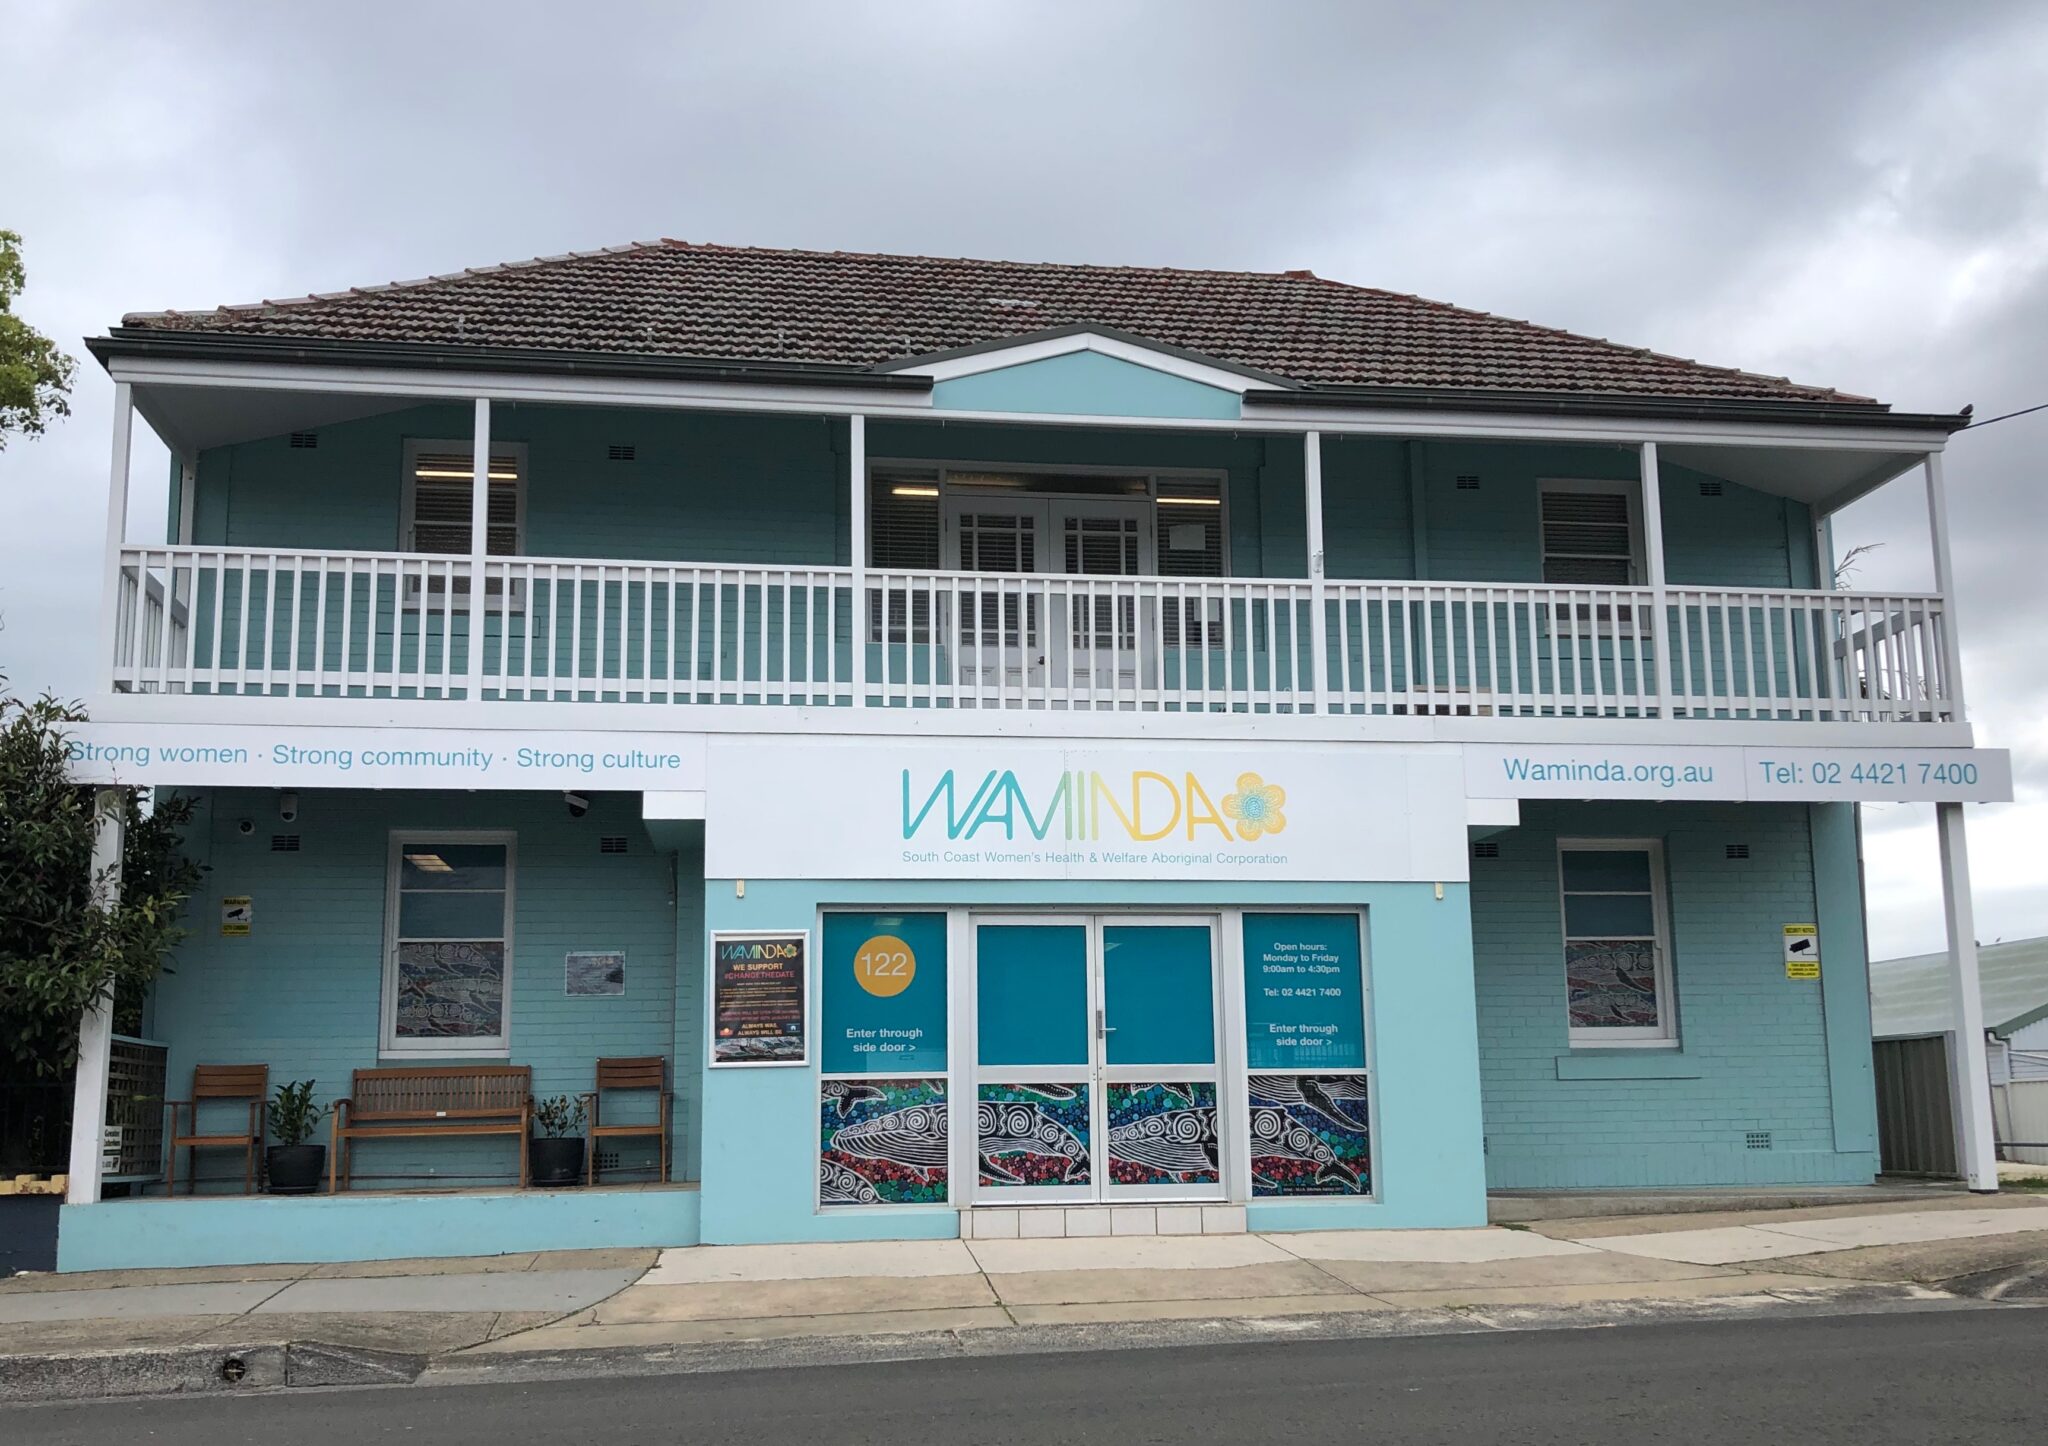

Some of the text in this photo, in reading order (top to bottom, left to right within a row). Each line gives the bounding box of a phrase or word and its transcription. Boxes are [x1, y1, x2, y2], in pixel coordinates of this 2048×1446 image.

[68, 741, 681, 773] Strong women Strong community Strong culture
[1503, 758, 1714, 788] Waminda.org.au
[1759, 762, 1978, 784] Tel: 02 4421 7400
[902, 769, 1235, 842] WAMINDA
[902, 851, 1288, 865] South Coast Women's Health & Welfare Aboriginal Corporation
[721, 944, 787, 959] WAMINDA
[1273, 942, 1327, 952] Open hours:
[861, 952, 907, 976] 122
[1263, 954, 1339, 963] Monday to Friday
[733, 962, 783, 971] WE SUPPORT
[1262, 965, 1340, 974] 9:00am to 4:30pm
[724, 971, 795, 980] #CHANGETHEDATE
[1263, 988, 1342, 997] Tel: 02 4421 7400
[846, 1028, 923, 1040] Enter through
[1269, 1024, 1338, 1035] Enter through
[853, 1042, 906, 1052] side door
[1276, 1037, 1324, 1046] side door
